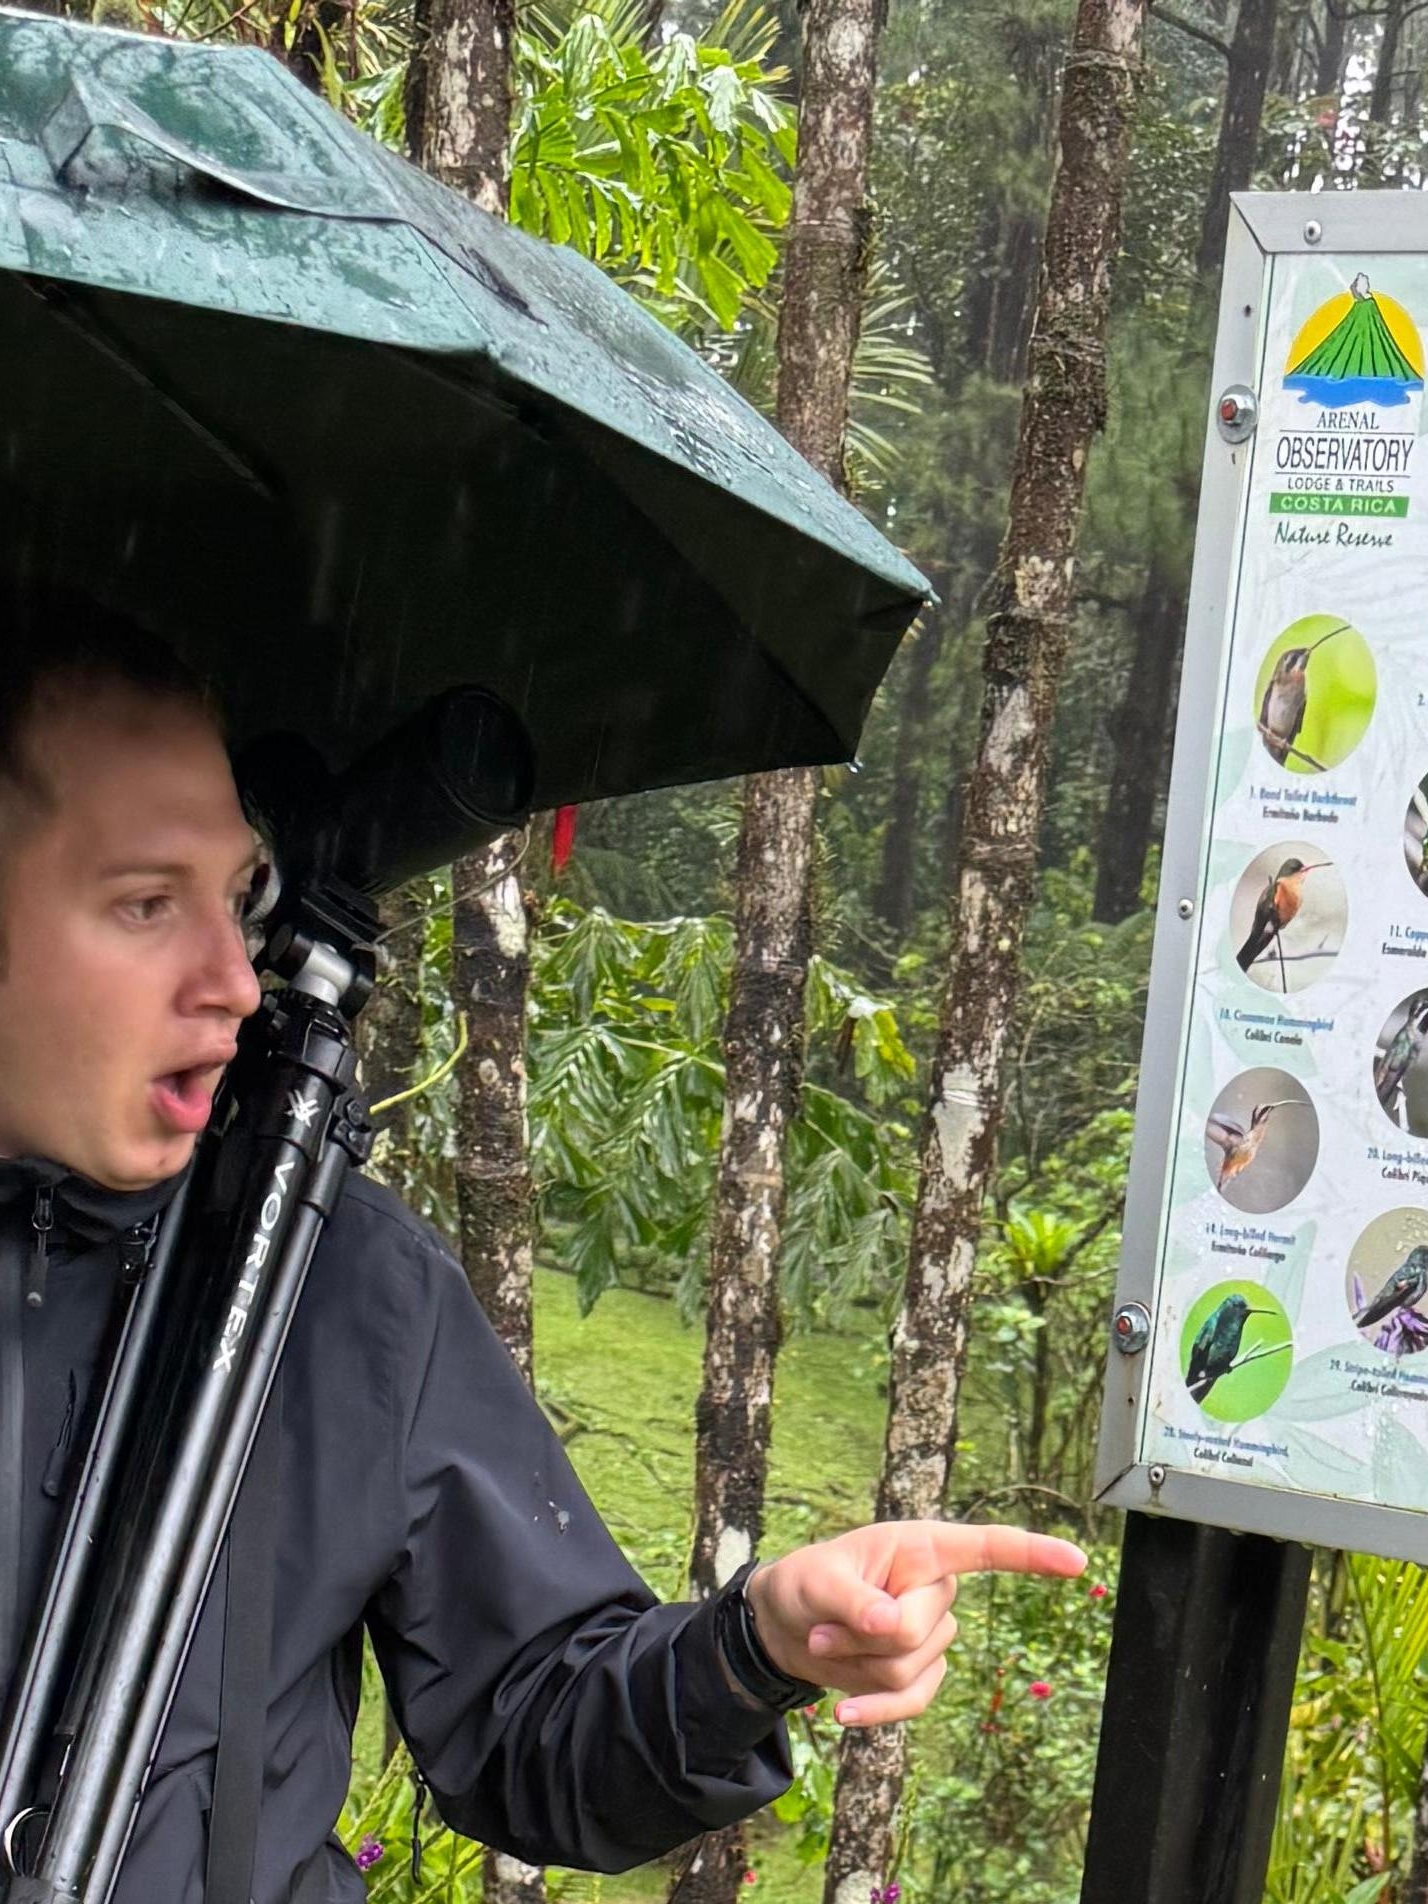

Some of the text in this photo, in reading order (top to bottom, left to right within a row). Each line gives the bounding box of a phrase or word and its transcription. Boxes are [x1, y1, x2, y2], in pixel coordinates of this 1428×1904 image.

[1316, 411, 1379, 430] ARENAL
[1276, 435, 1414, 472] OBSERVATORY
[1288, 477, 1394, 493] LODGE & TRAILS
[1280, 496, 1397, 514] COSTA RICA
[1274, 521, 1393, 548] Nature Reserve
[212, 1161, 295, 1373] VORTEX
